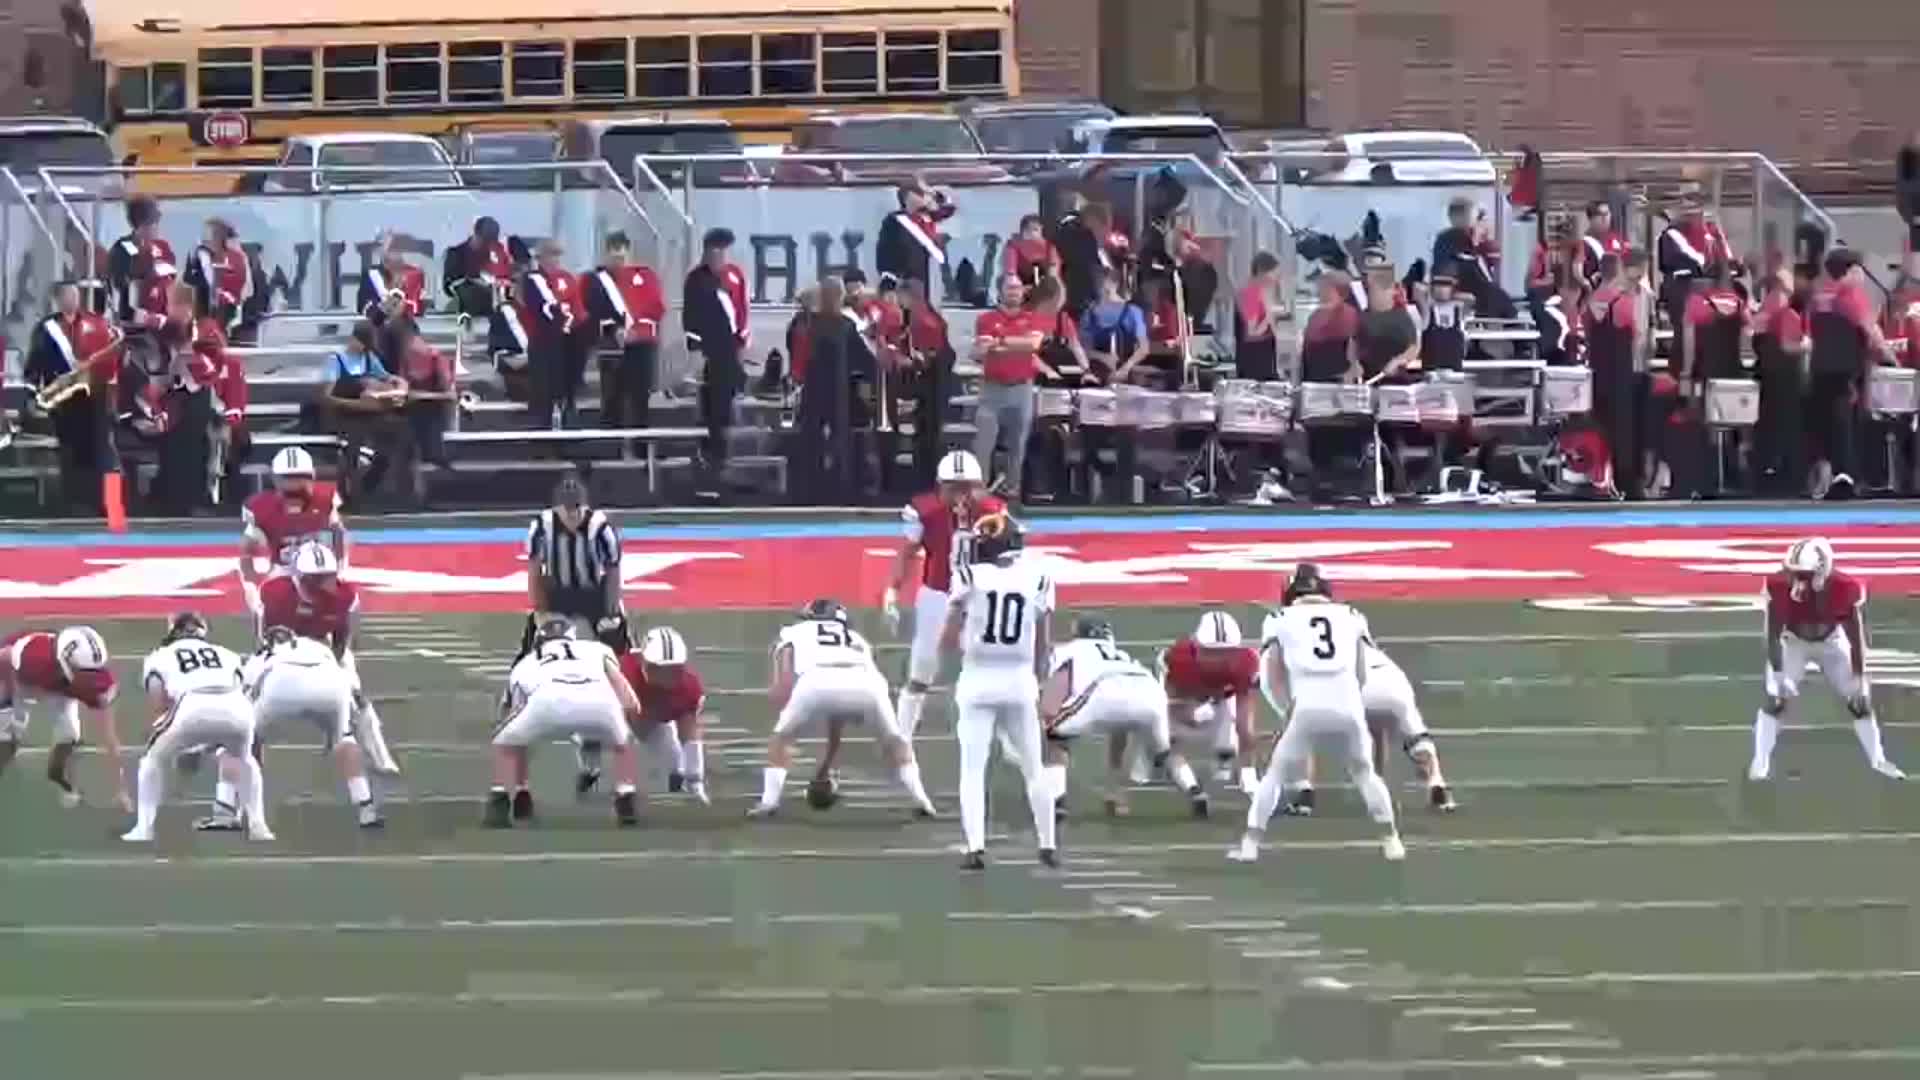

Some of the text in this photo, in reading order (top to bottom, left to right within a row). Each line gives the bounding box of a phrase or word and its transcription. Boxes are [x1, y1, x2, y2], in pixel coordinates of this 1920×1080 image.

[984, 591, 1024, 644] 10
[1310, 616, 1335, 659] 3
[175, 647, 223, 673] 88
